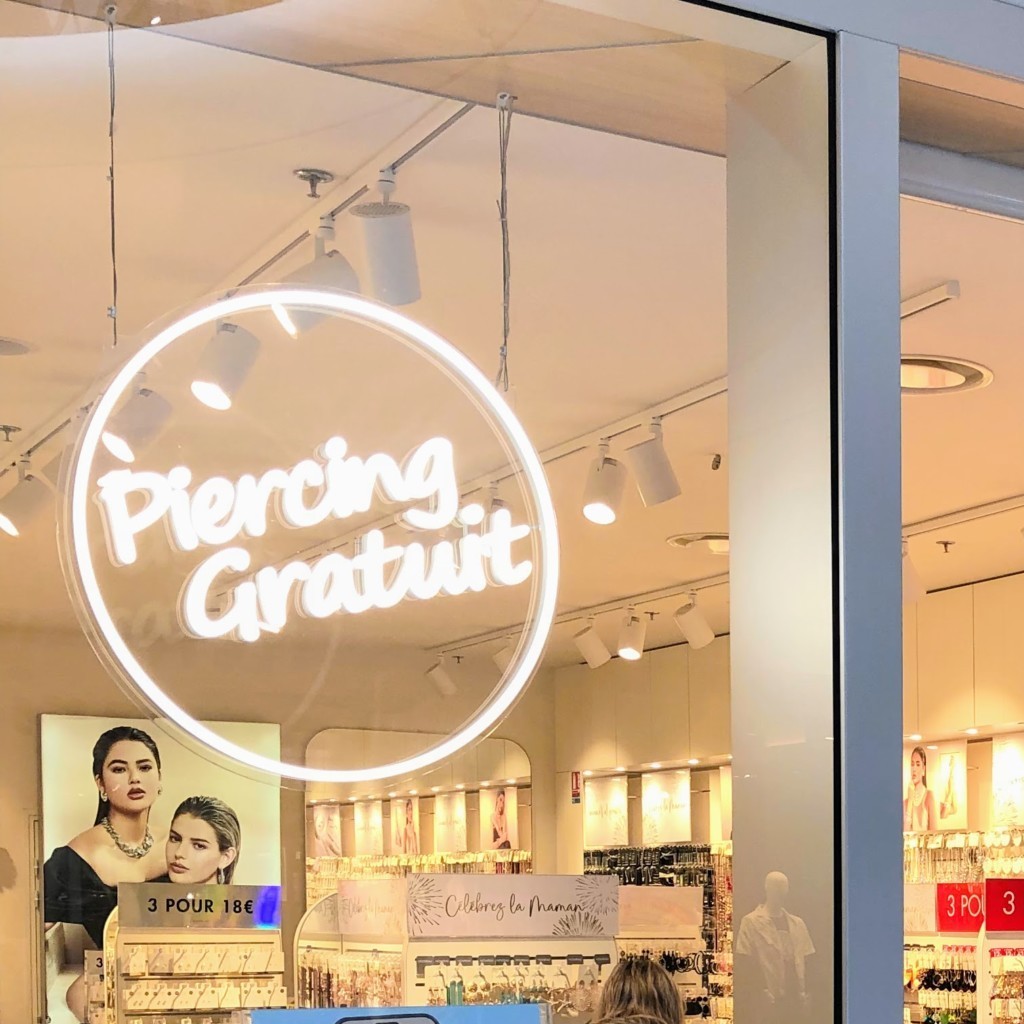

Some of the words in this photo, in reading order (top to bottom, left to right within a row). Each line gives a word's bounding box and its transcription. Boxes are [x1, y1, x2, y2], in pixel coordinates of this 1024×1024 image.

[97, 435, 459, 567] Piercing
[180, 503, 532, 642] Gratuit
[147, 898, 158, 913] 3
[165, 898, 214, 914] POUR
[223, 899, 254, 914] 18€
[509, 893, 525, 914] la
[529, 895, 585, 917] Maman
[947, 894, 956, 918] 3
[1002, 891, 1016, 915] 3
